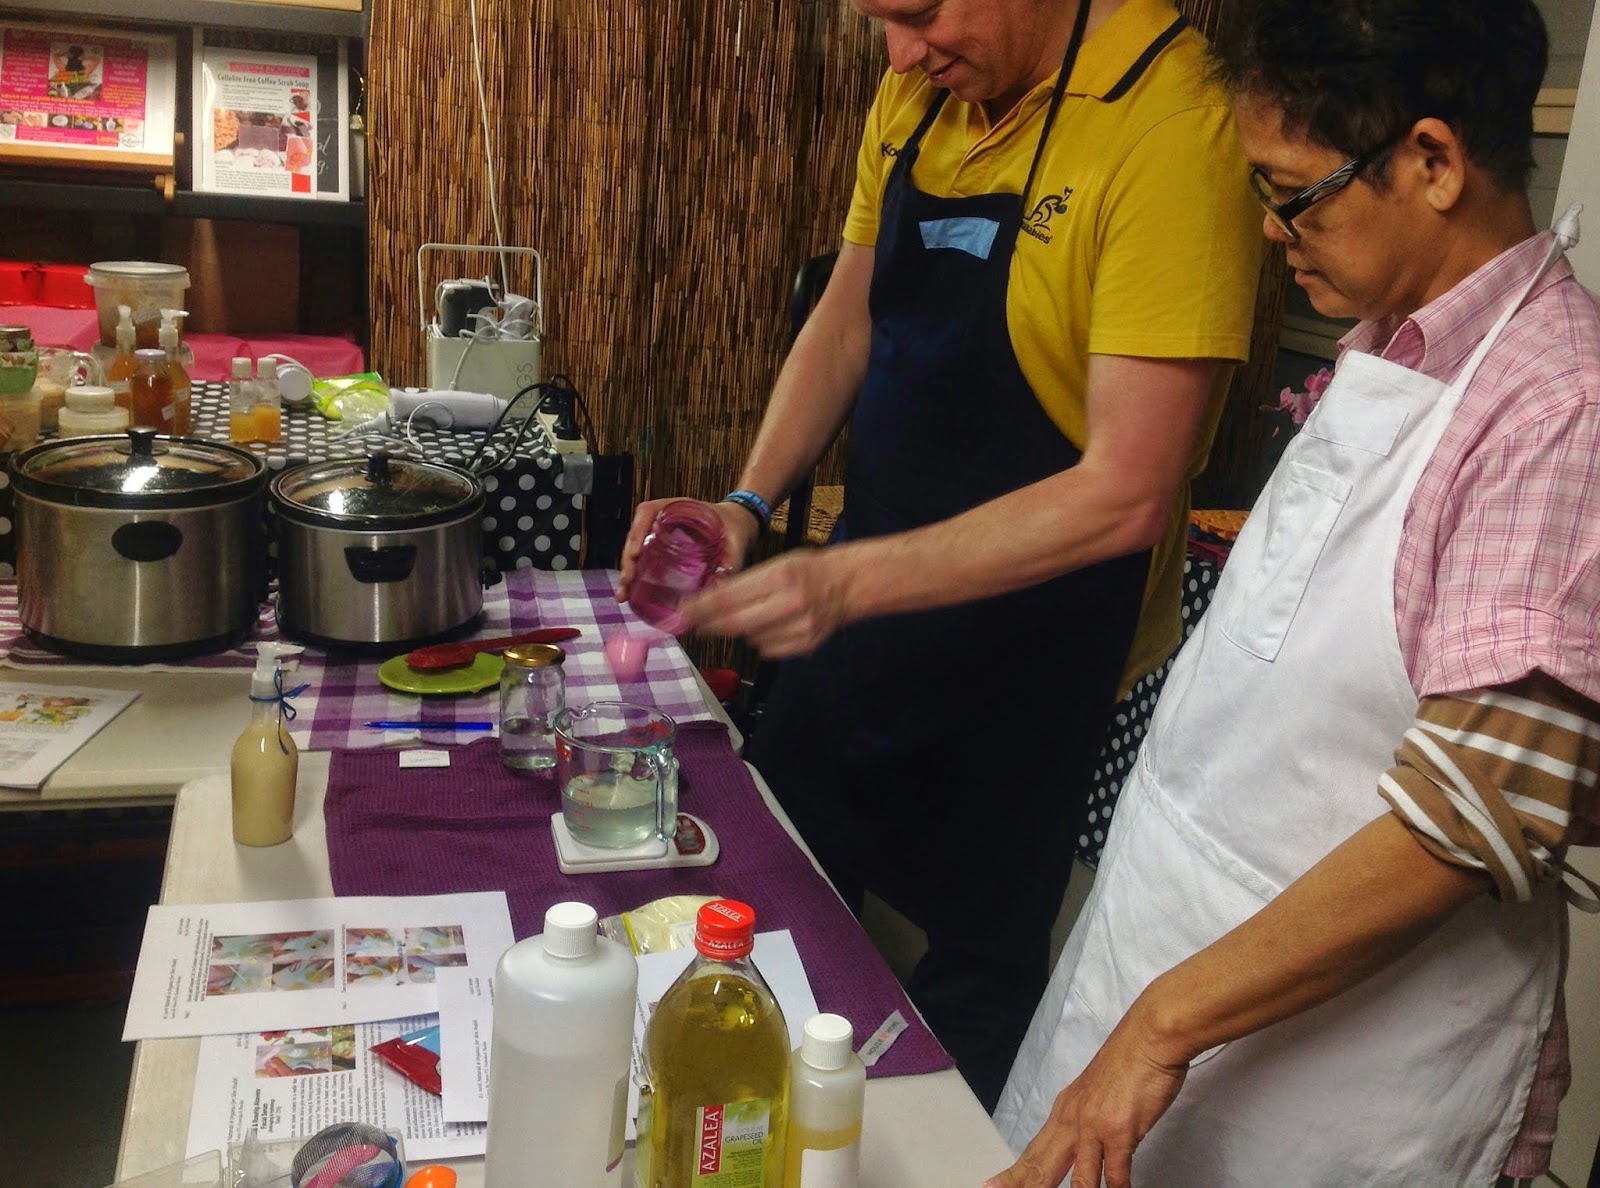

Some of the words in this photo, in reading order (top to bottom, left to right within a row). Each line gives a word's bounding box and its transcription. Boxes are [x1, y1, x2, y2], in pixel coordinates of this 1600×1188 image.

[258, 77, 276, 85] Coffee
[295, 80, 309, 89] Soap
[702, 1111, 720, 1170] AZALEA
[725, 1132, 764, 1143] GRAPESEED
